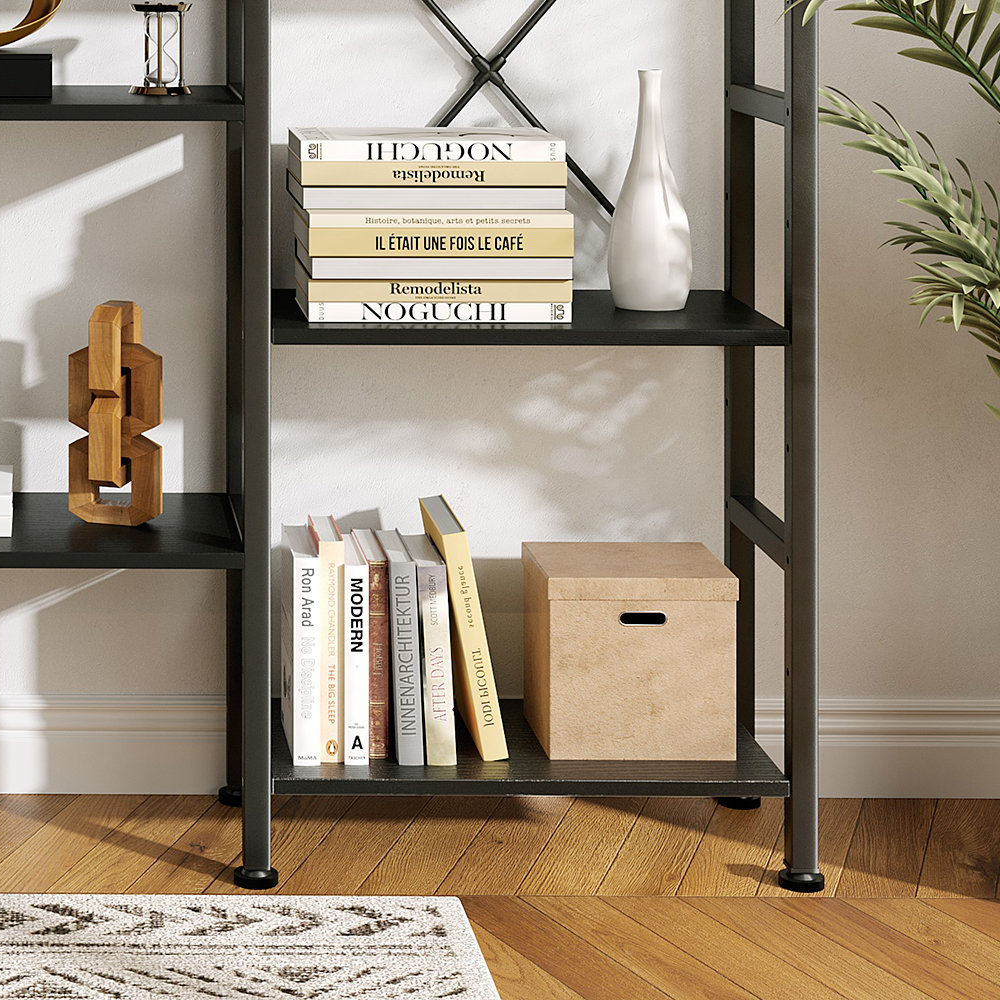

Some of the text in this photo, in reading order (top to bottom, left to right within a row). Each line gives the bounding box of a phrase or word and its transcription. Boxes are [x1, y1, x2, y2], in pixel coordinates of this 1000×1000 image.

[366, 143, 513, 161] NOGUCHI
[393, 170, 486, 182] Remodelista
[365, 217, 400, 226] Histoire,
[402, 217, 443, 226] botanique,
[475, 217, 500, 227] petits
[375, 233, 524, 251] IL ÉTAIT UNE FOIS LE CAFÉ
[390, 282, 482, 295] Remodelista
[361, 302, 507, 321] NOGUCHI
[301, 568, 315, 593] Ron
[301, 596, 315, 627] Arad
[350, 578, 364, 653] MODERN
[328, 562, 336, 725] RAYMOND CHANDLER THE BIG SLEEP
[395, 575, 417, 737] INNENARCHITEKTUR
[431, 646, 447, 722] AFTER DAYS
[352, 734, 364, 750] A
